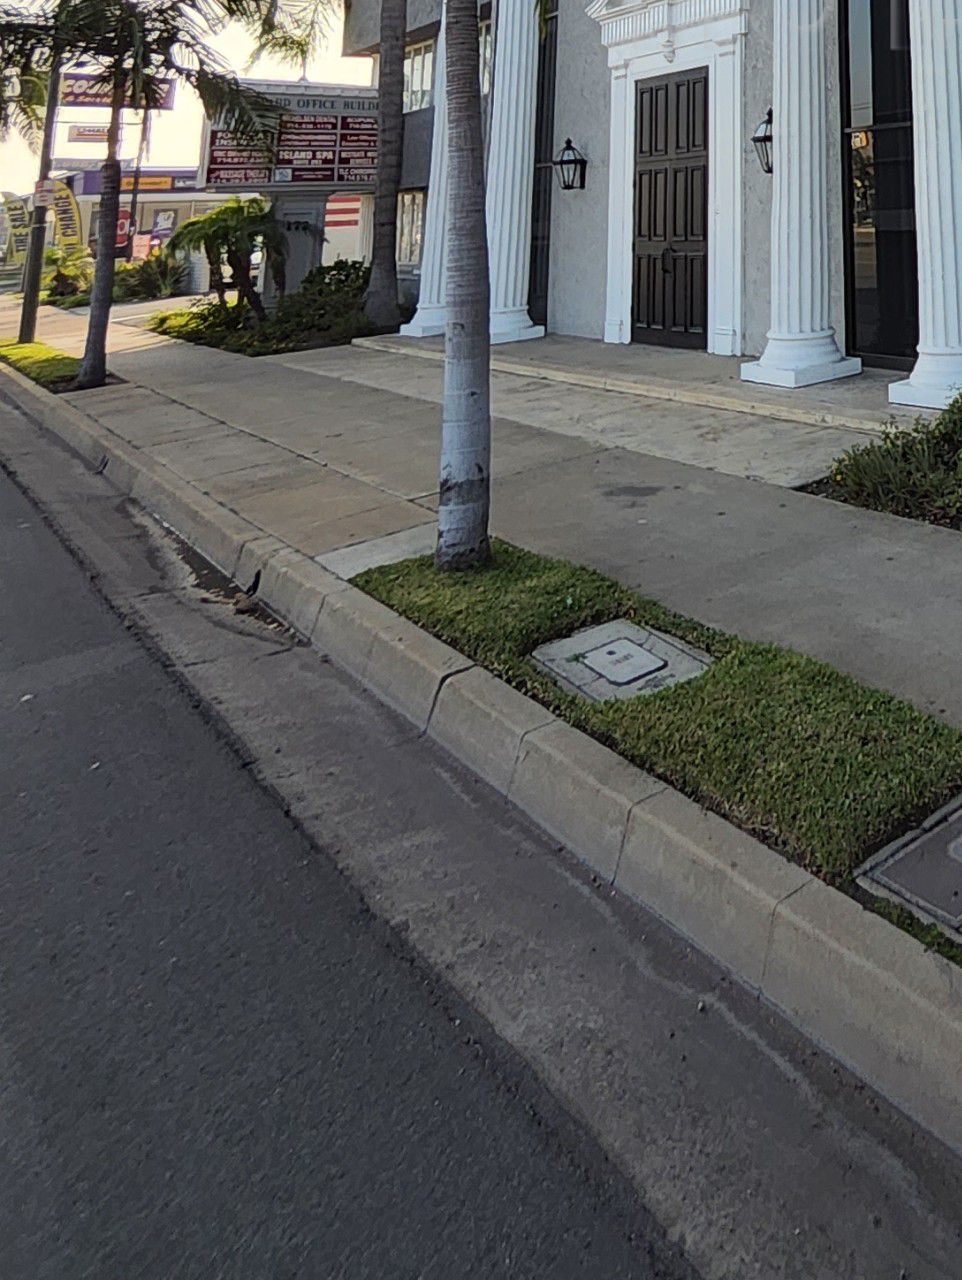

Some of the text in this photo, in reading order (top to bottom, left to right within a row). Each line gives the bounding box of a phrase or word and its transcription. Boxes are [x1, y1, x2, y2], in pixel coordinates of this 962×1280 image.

[297, 99, 337, 110] OFFICE
[279, 150, 313, 160] ISLAND
[315, 150, 333, 160] SPA
[8, 204, 26, 229] SALE
[54, 193, 78, 238] CHANGE
